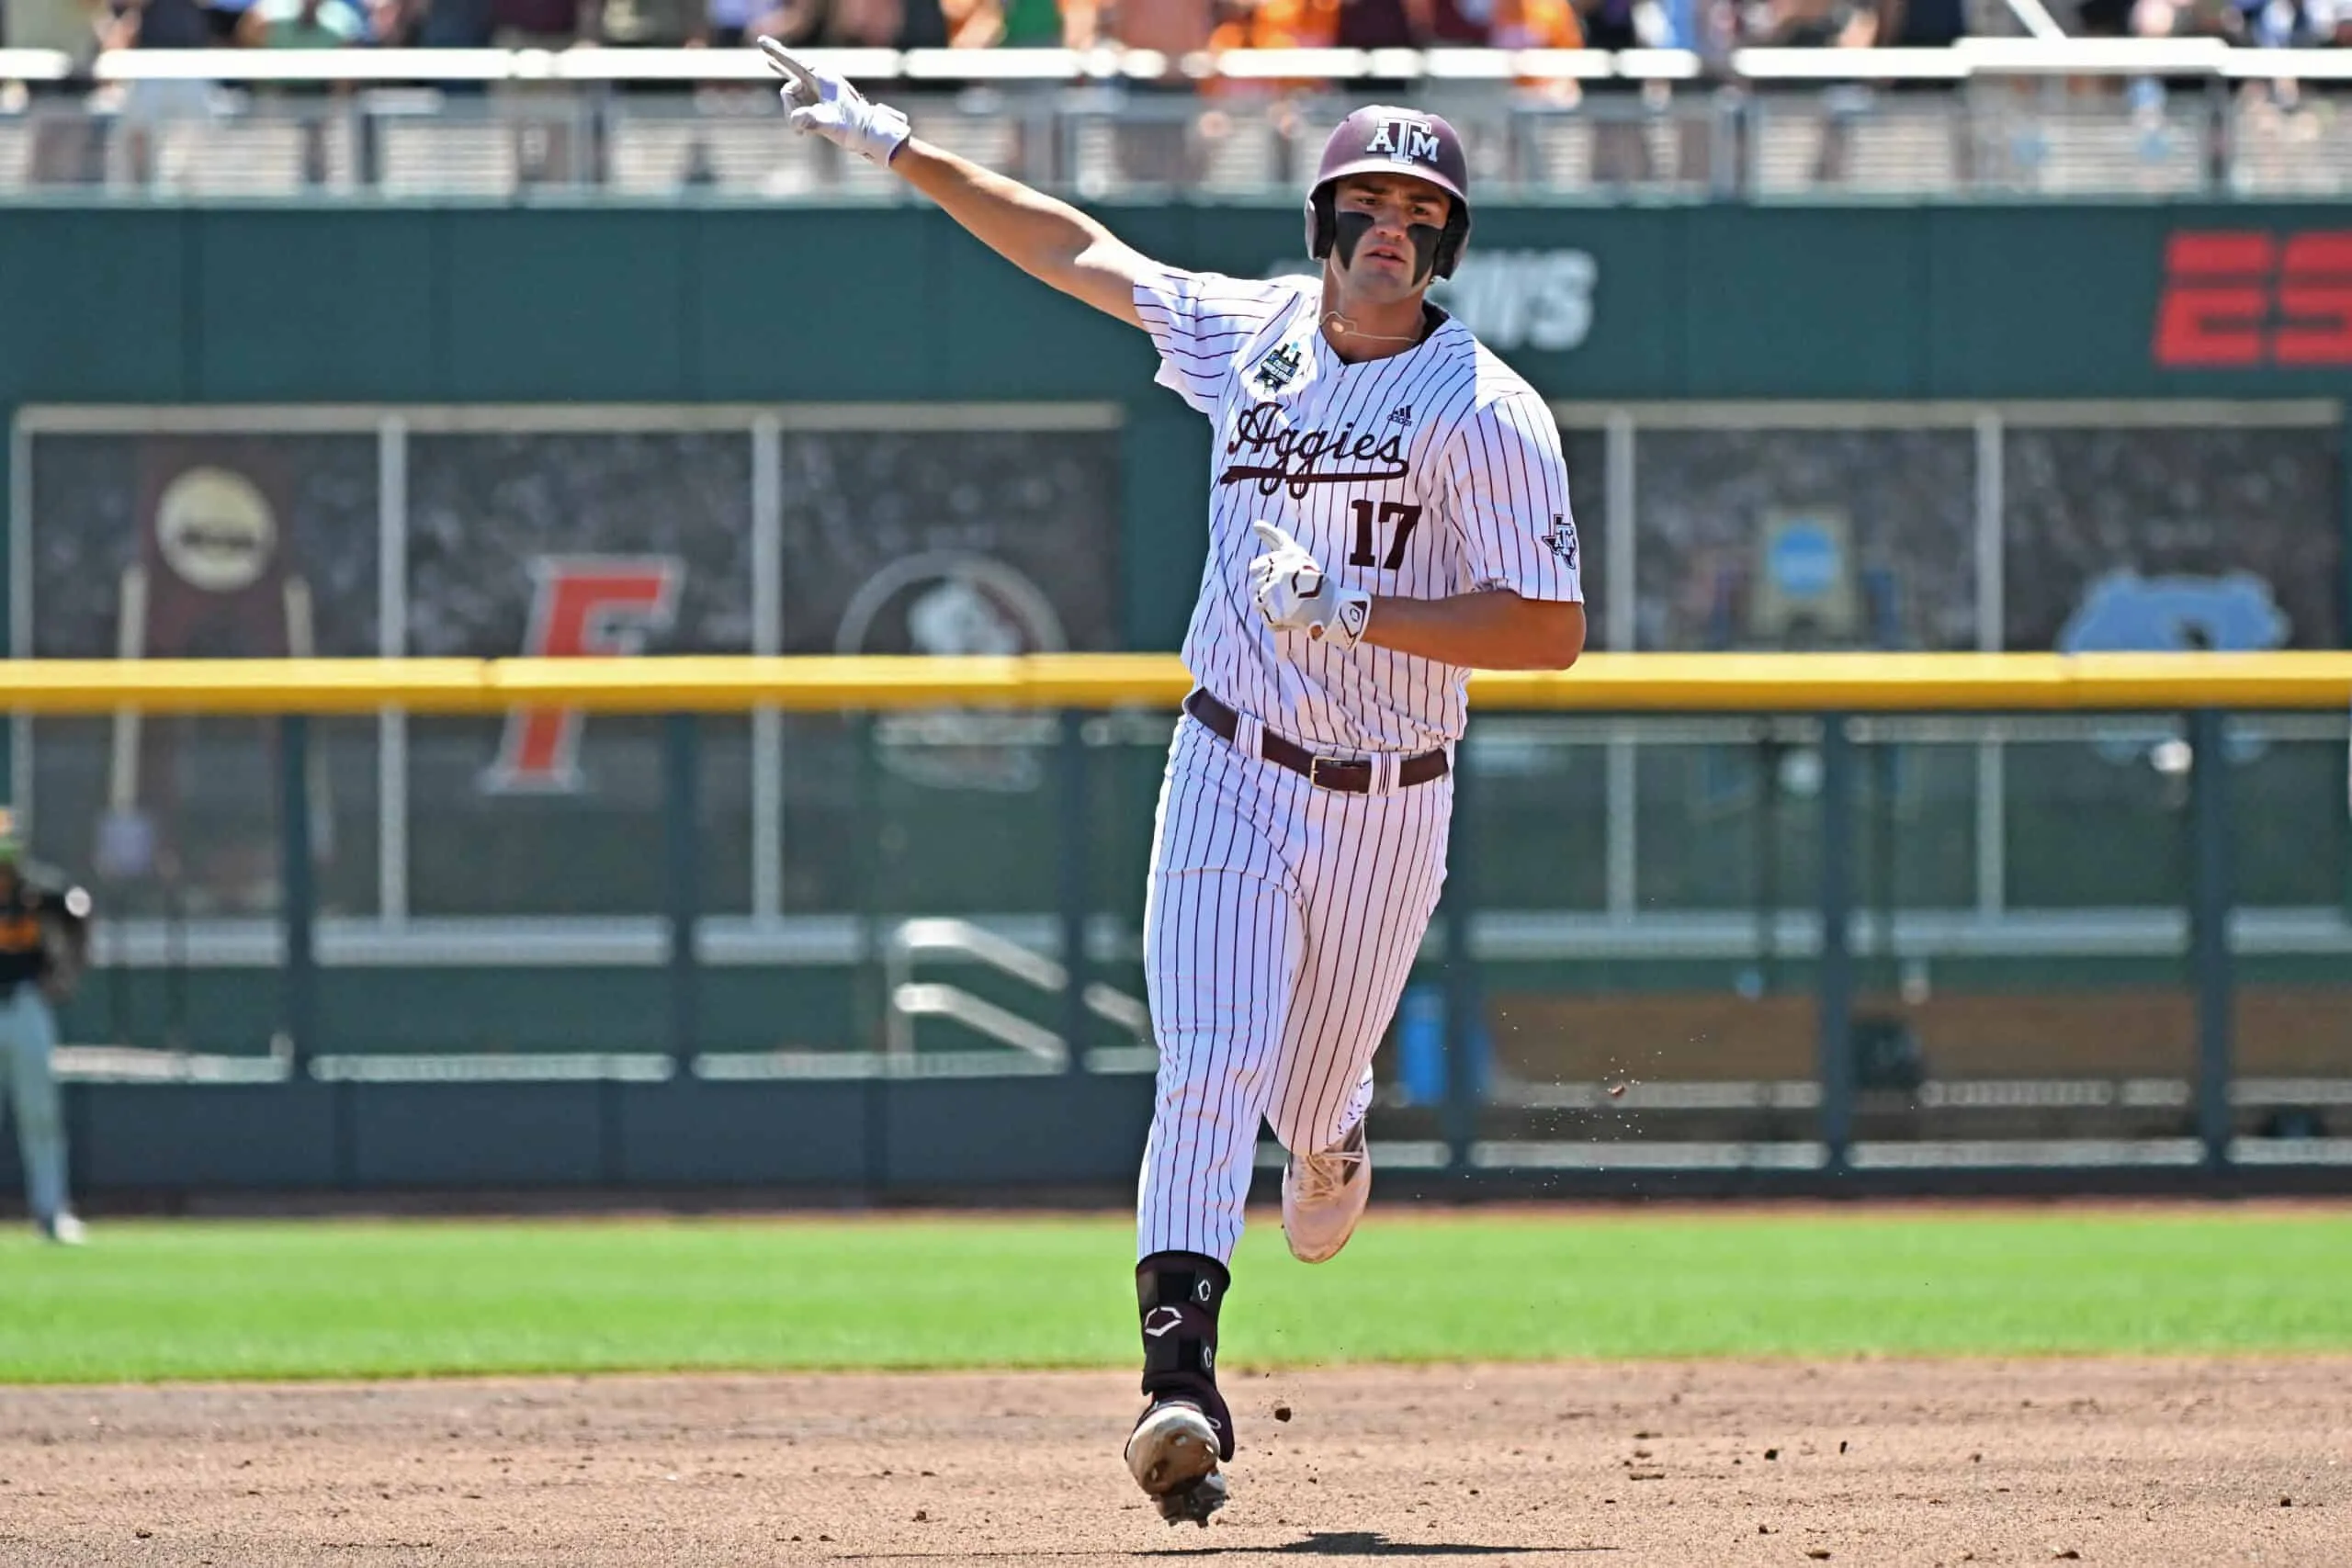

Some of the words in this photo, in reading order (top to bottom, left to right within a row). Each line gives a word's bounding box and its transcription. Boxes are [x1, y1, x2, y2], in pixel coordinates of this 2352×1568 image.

[1222, 401, 1409, 500] Aggies
[1386, 413, 1412, 427] adidas
[1350, 499, 1422, 570] 17
